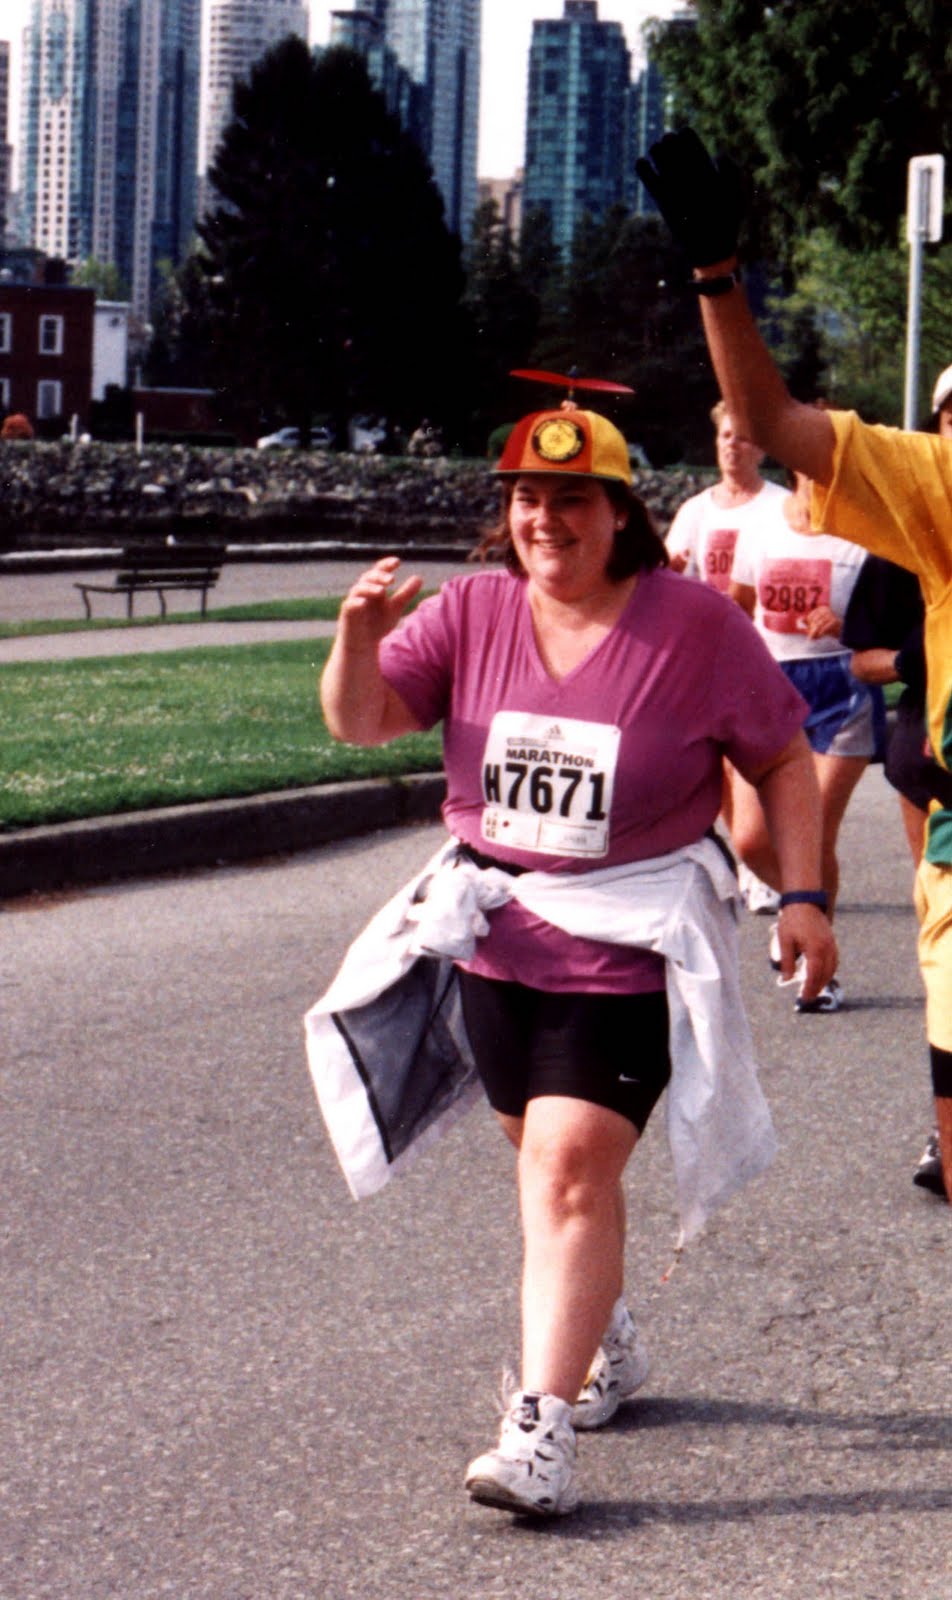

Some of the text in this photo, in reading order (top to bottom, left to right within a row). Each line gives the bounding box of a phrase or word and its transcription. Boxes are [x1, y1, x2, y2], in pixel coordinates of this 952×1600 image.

[706, 551, 733, 575] 30
[763, 585, 822, 613] 2987
[505, 748, 595, 768] MARATHON
[484, 763, 606, 821] H7671
